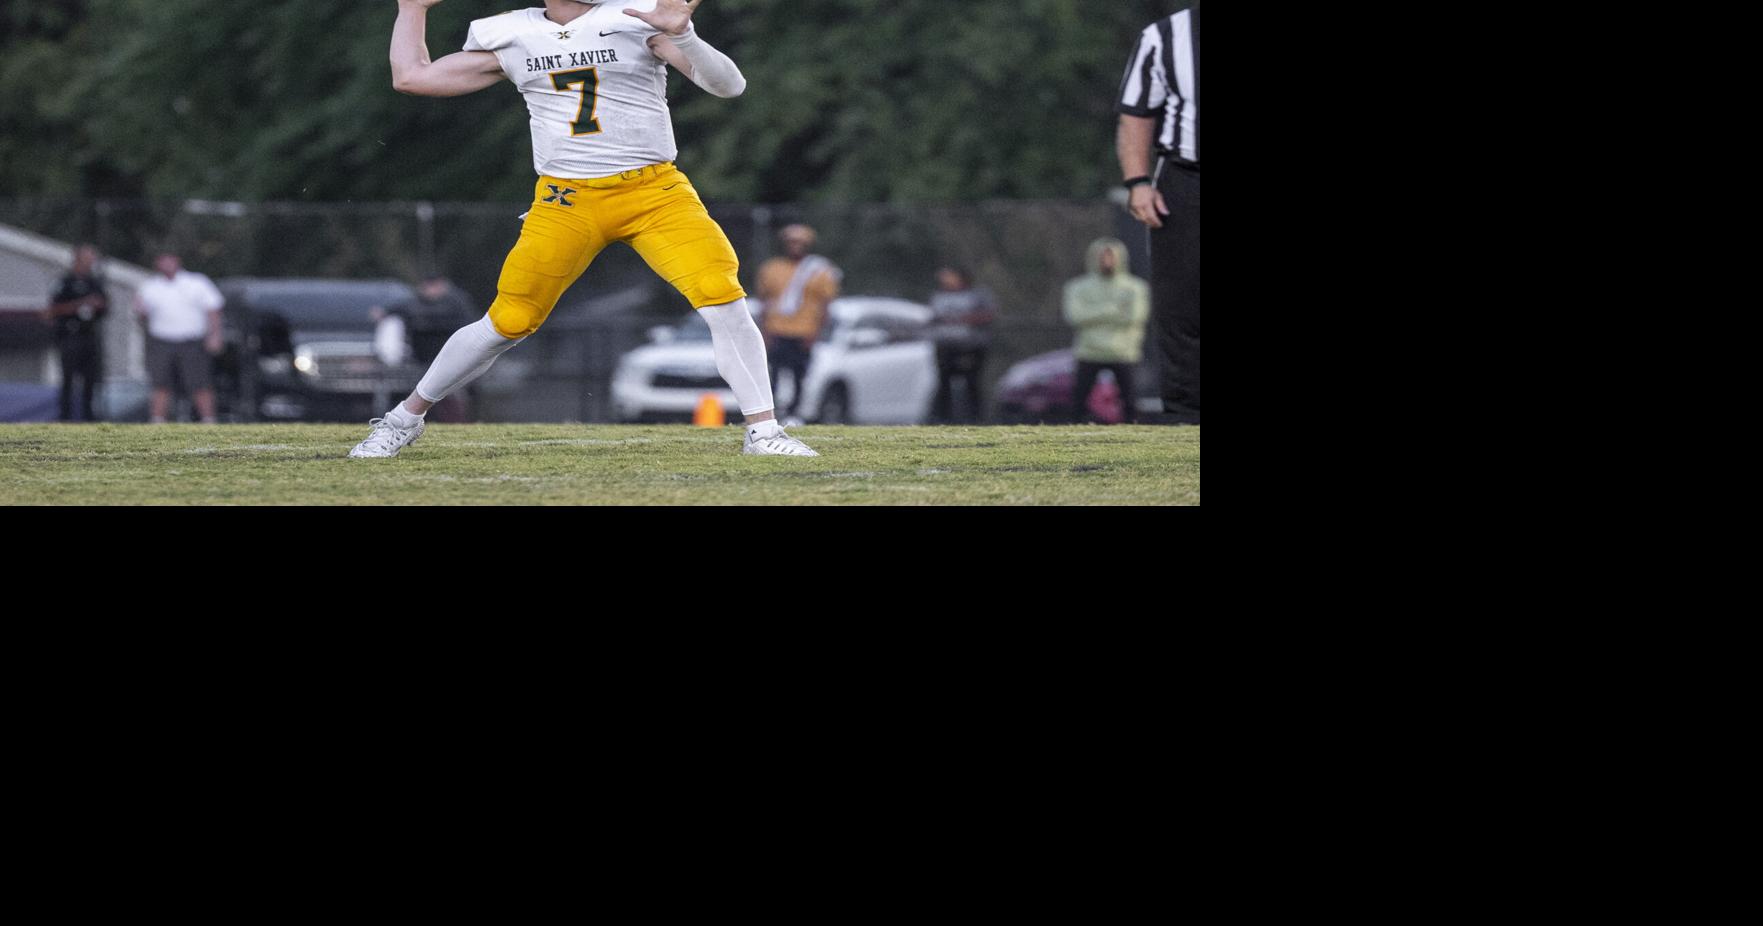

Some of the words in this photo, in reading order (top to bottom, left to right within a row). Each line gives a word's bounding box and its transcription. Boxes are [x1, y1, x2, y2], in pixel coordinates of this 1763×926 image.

[527, 55, 562, 72] SAINT
[569, 48, 619, 67] XAVIER
[549, 66, 602, 136] 7
[542, 184, 577, 207] X
